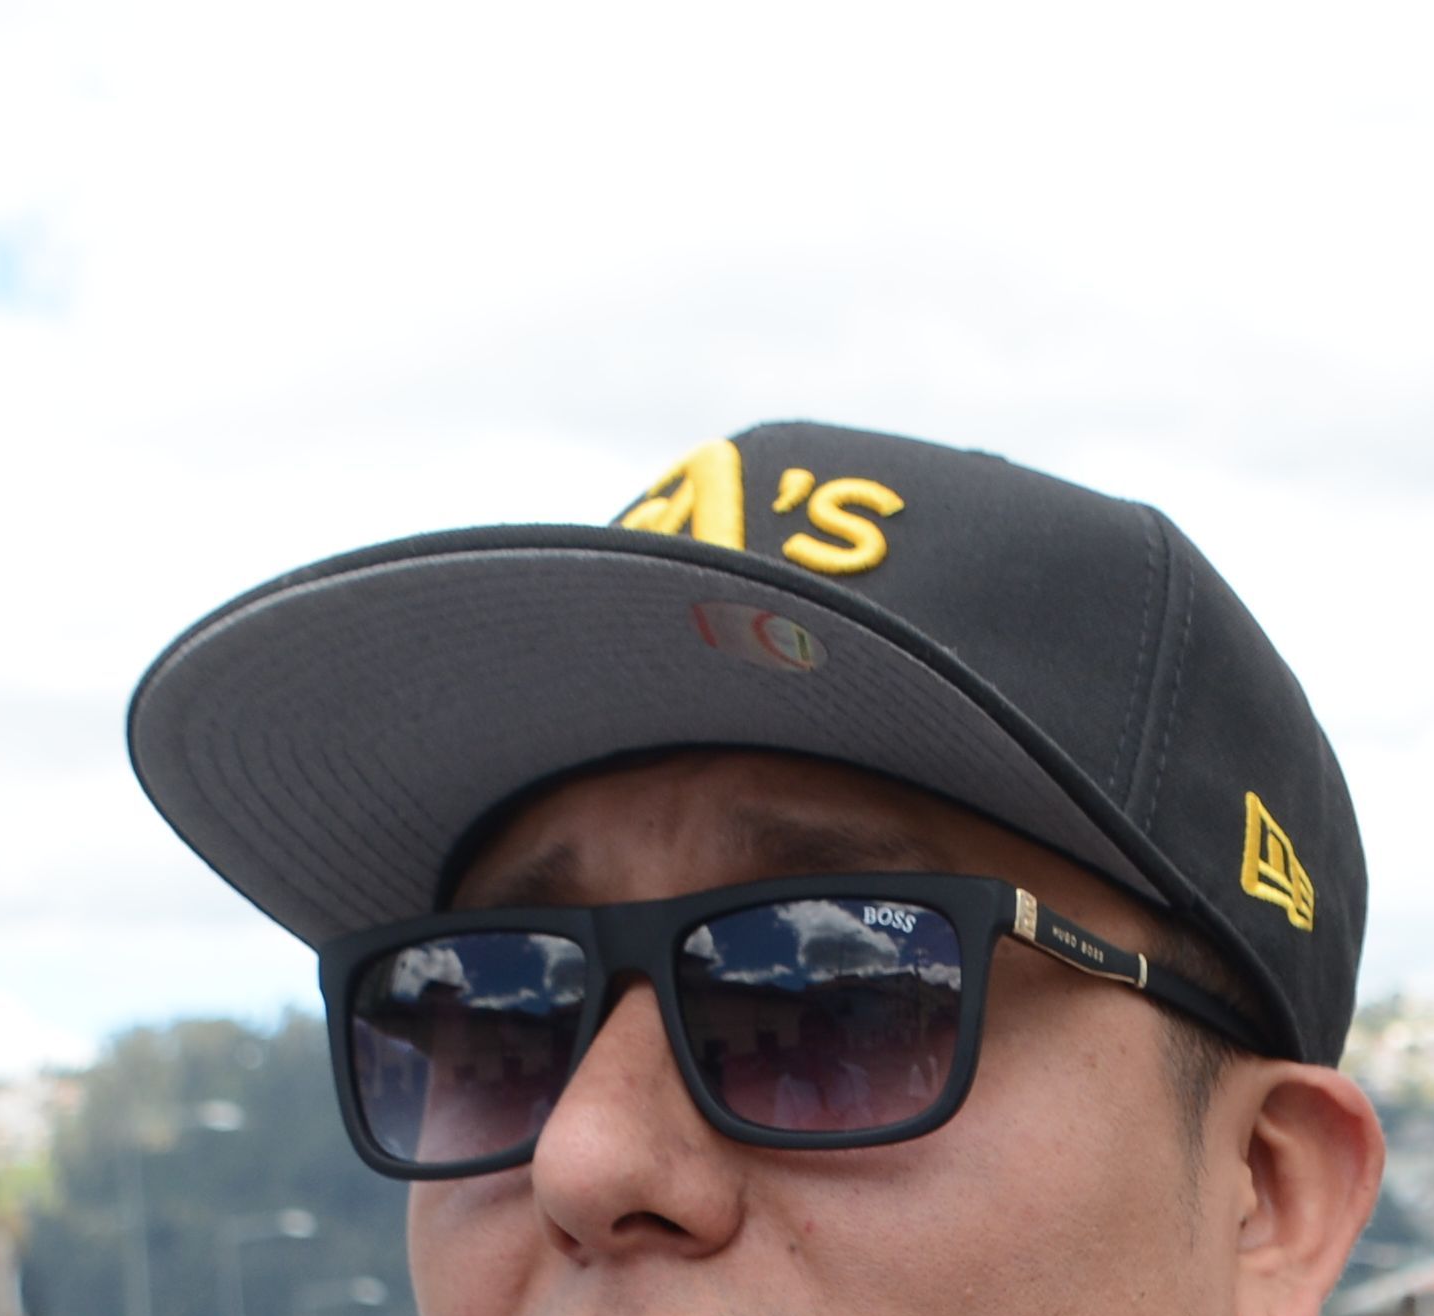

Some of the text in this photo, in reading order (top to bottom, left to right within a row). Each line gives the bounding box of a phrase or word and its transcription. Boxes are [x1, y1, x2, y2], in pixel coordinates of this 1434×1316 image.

[863, 905, 917, 934] BOSS
[1052, 924, 1105, 964] HUGO BOSS
